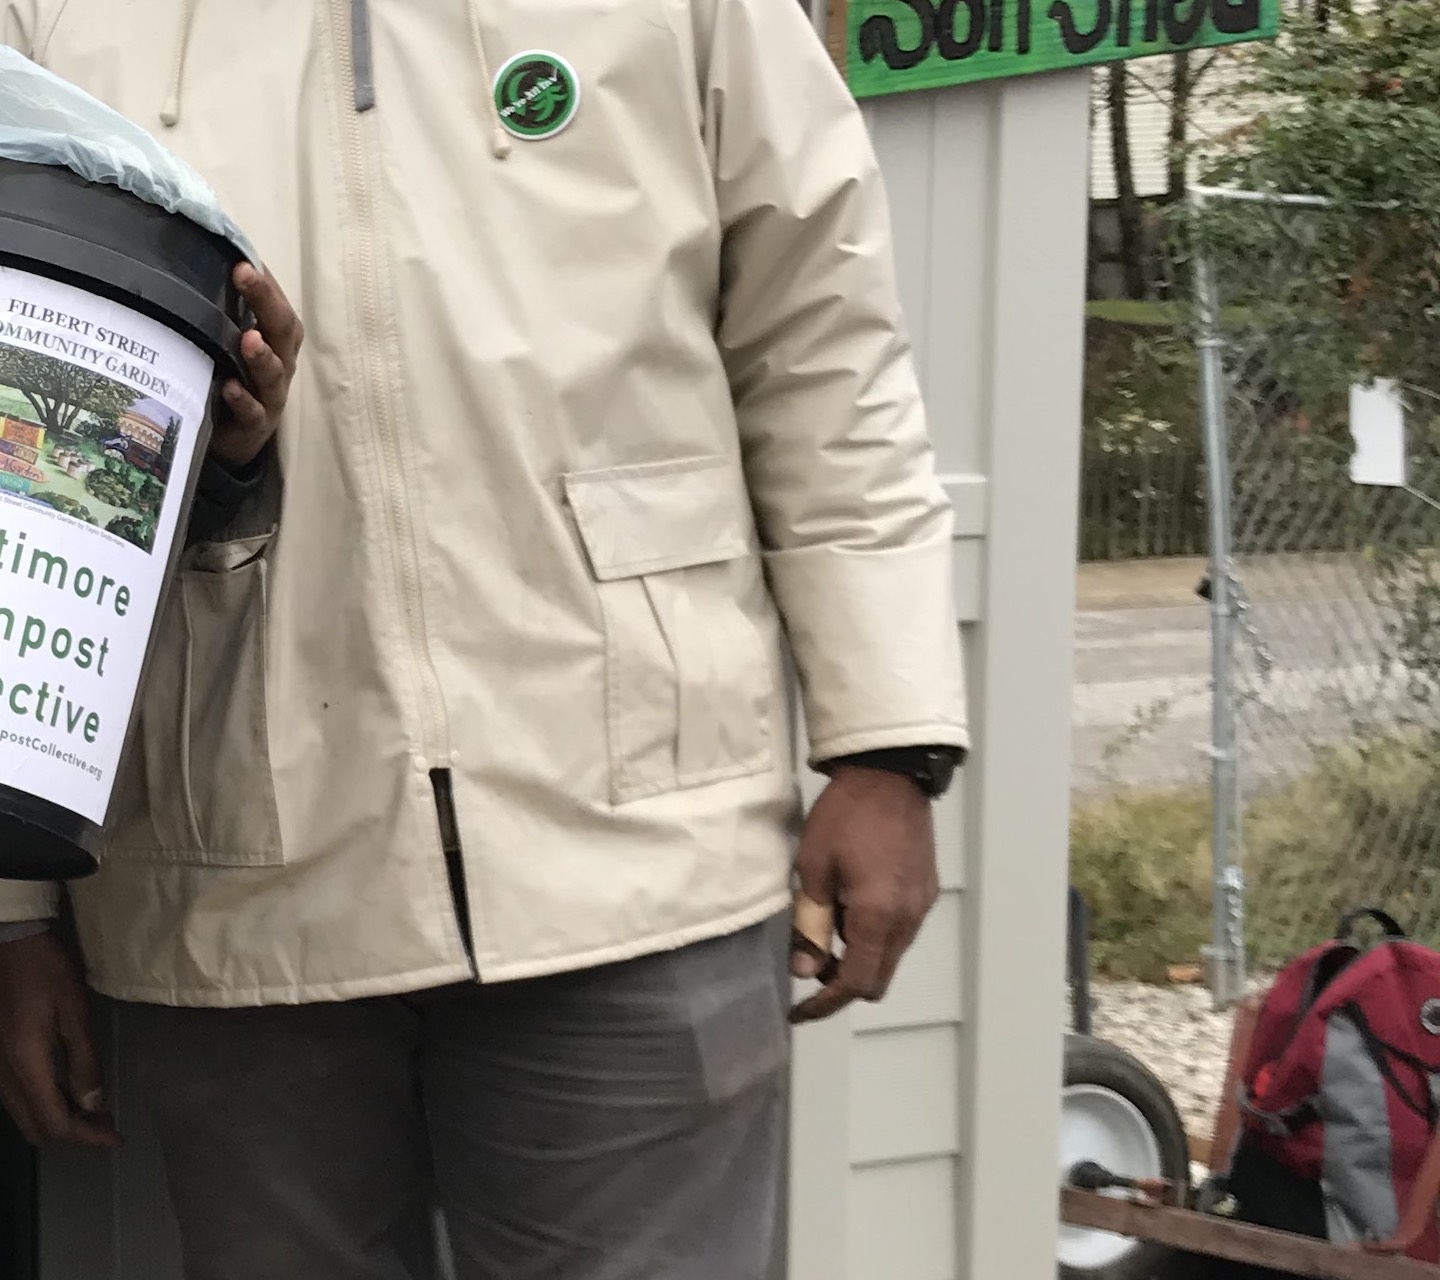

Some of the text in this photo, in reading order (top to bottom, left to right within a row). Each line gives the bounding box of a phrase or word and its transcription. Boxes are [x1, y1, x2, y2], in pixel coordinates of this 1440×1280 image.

[8, 298, 160, 365] FILBERT STREET
[104, 355, 171, 397] GARDEN
